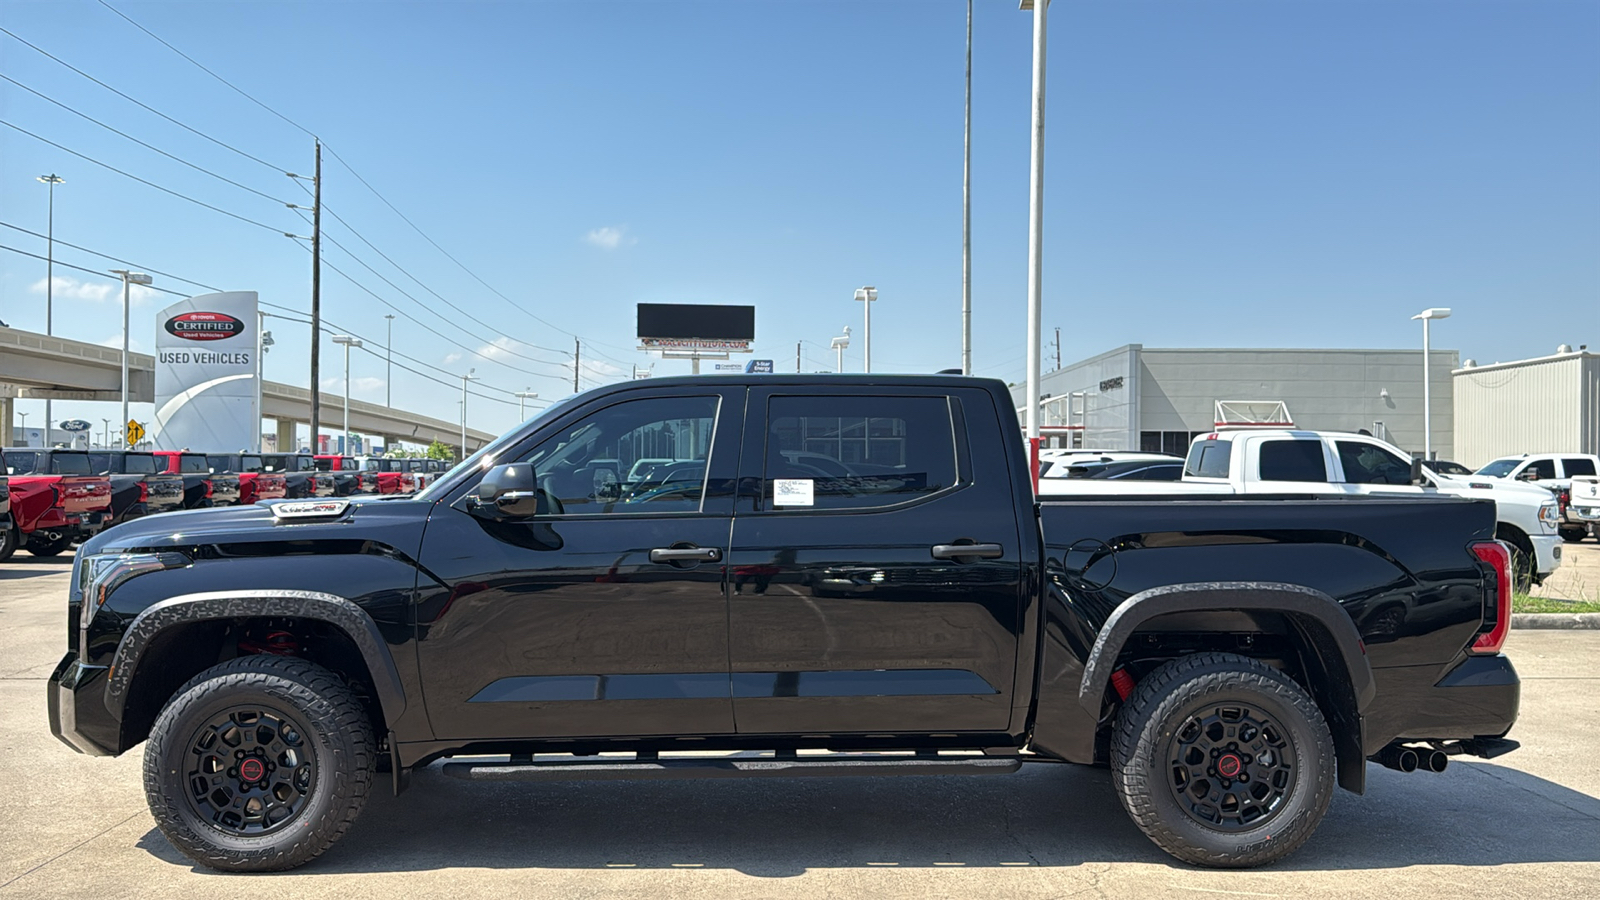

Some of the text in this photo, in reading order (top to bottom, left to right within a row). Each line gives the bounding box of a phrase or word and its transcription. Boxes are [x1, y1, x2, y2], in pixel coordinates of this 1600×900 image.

[174, 321, 234, 330] CERTIFIED
[160, 352, 250, 365] USED VEHICLES
[65, 421, 84, 430] Ford
